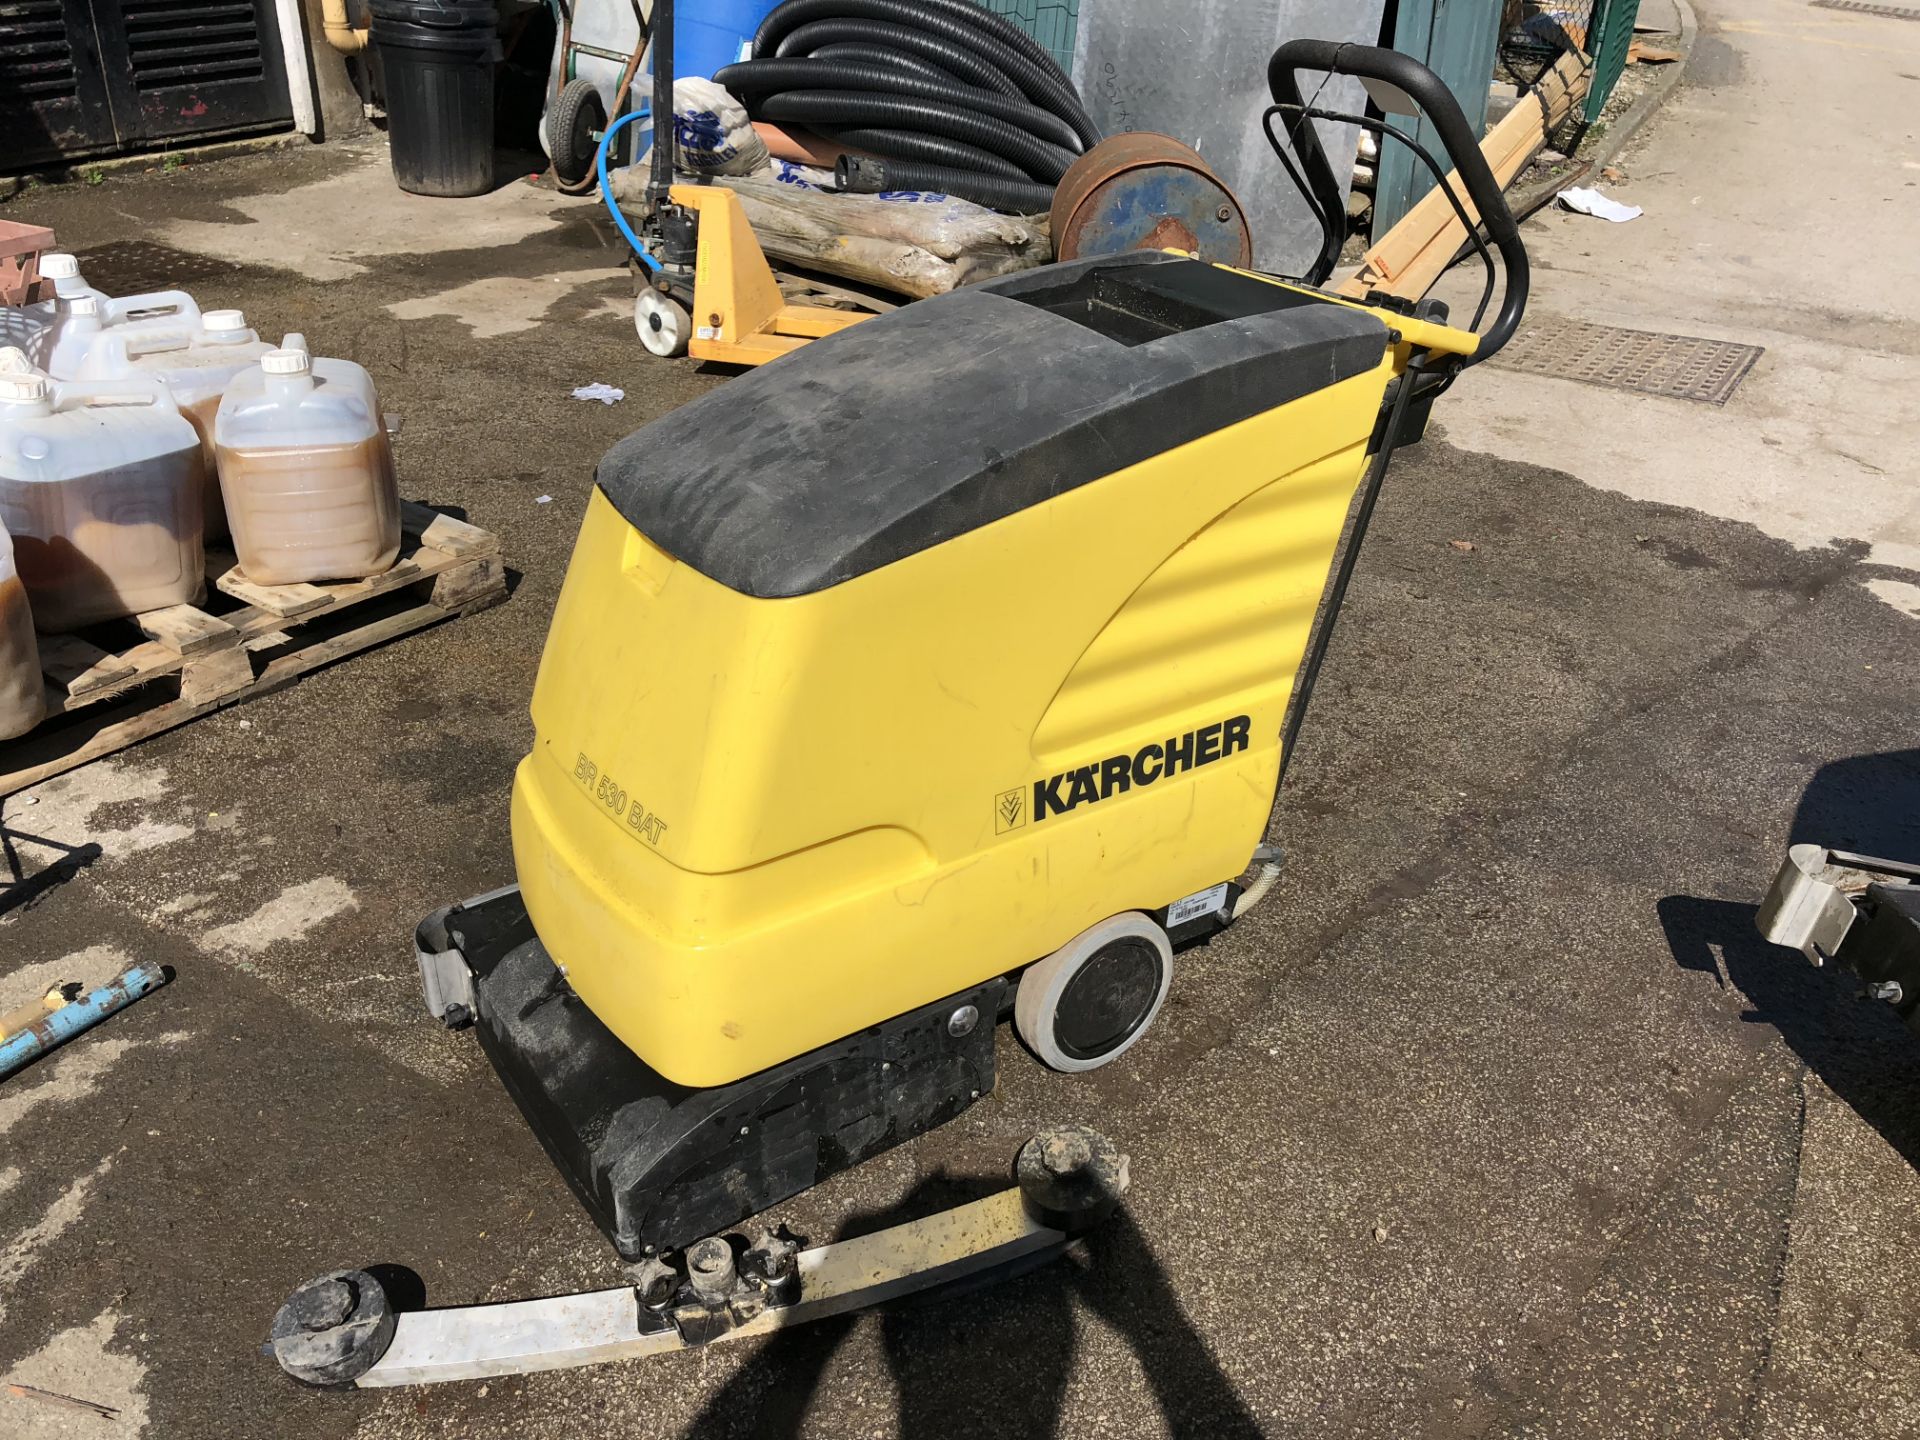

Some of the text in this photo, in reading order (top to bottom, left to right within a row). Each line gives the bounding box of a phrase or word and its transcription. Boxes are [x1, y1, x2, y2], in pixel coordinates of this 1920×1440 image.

[574, 752, 668, 845] BR 530 BAT
[1034, 715, 1252, 822] KÄRCHER
